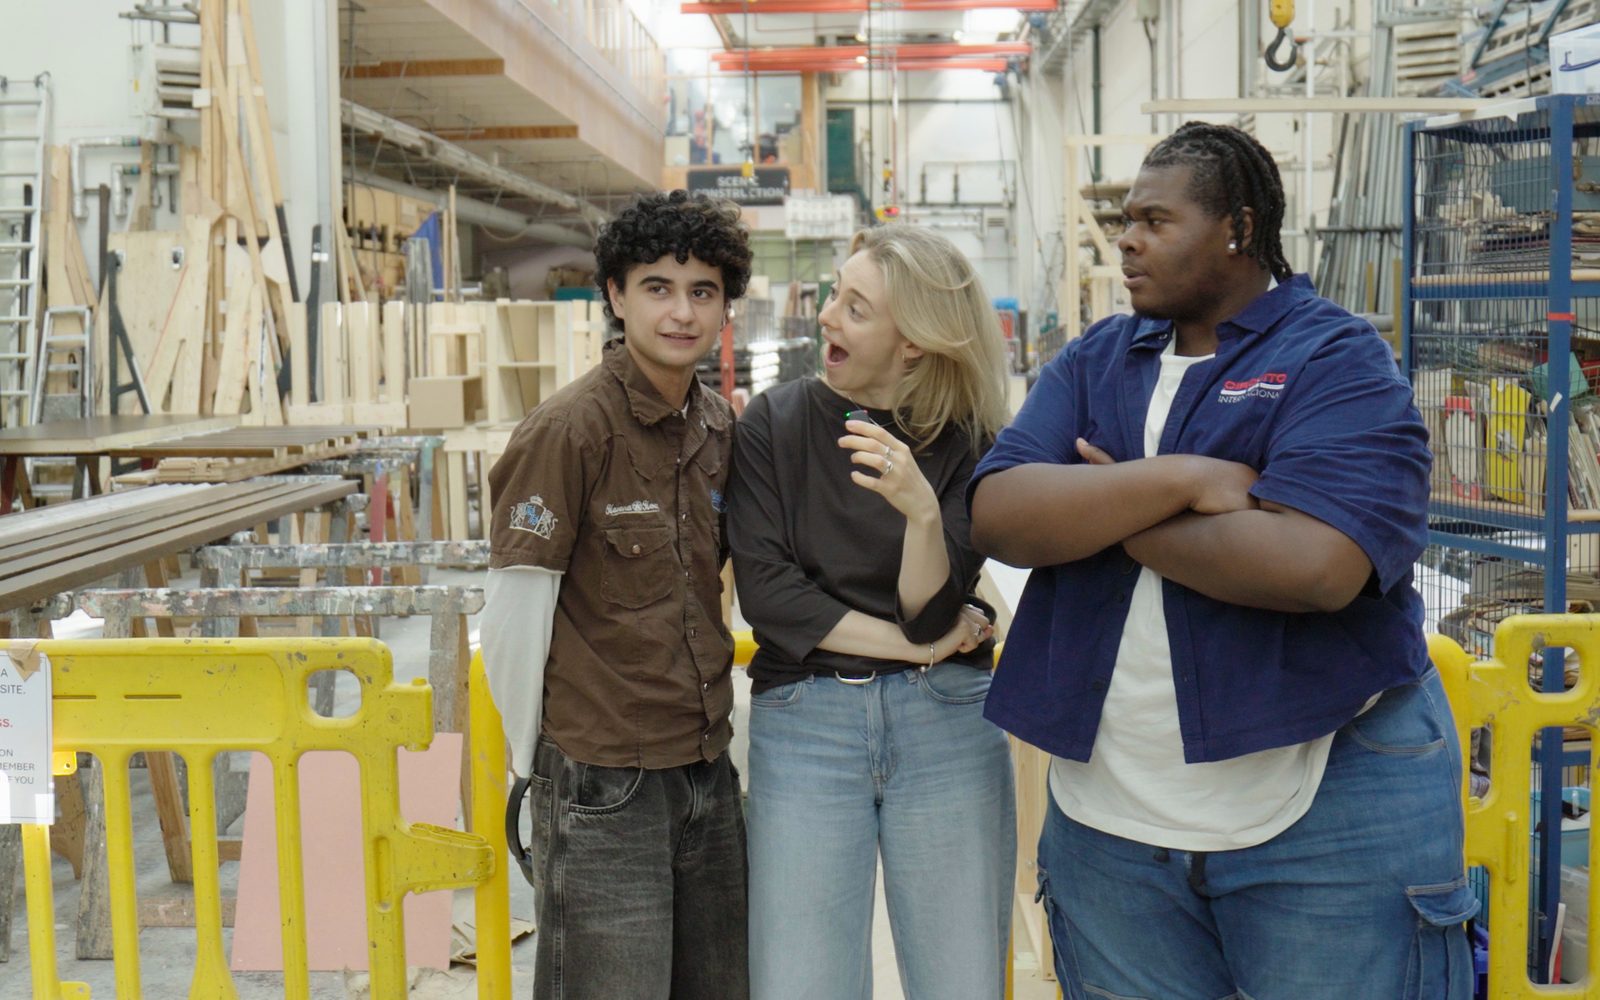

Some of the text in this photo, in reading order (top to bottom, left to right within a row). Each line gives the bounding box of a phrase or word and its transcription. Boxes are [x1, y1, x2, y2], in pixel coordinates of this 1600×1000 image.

[717, 176, 760, 187] SCENC
[1, 668, 8, 677] A
[0, 684, 26, 694] SITE.
[15, 775, 34, 784] YOU
